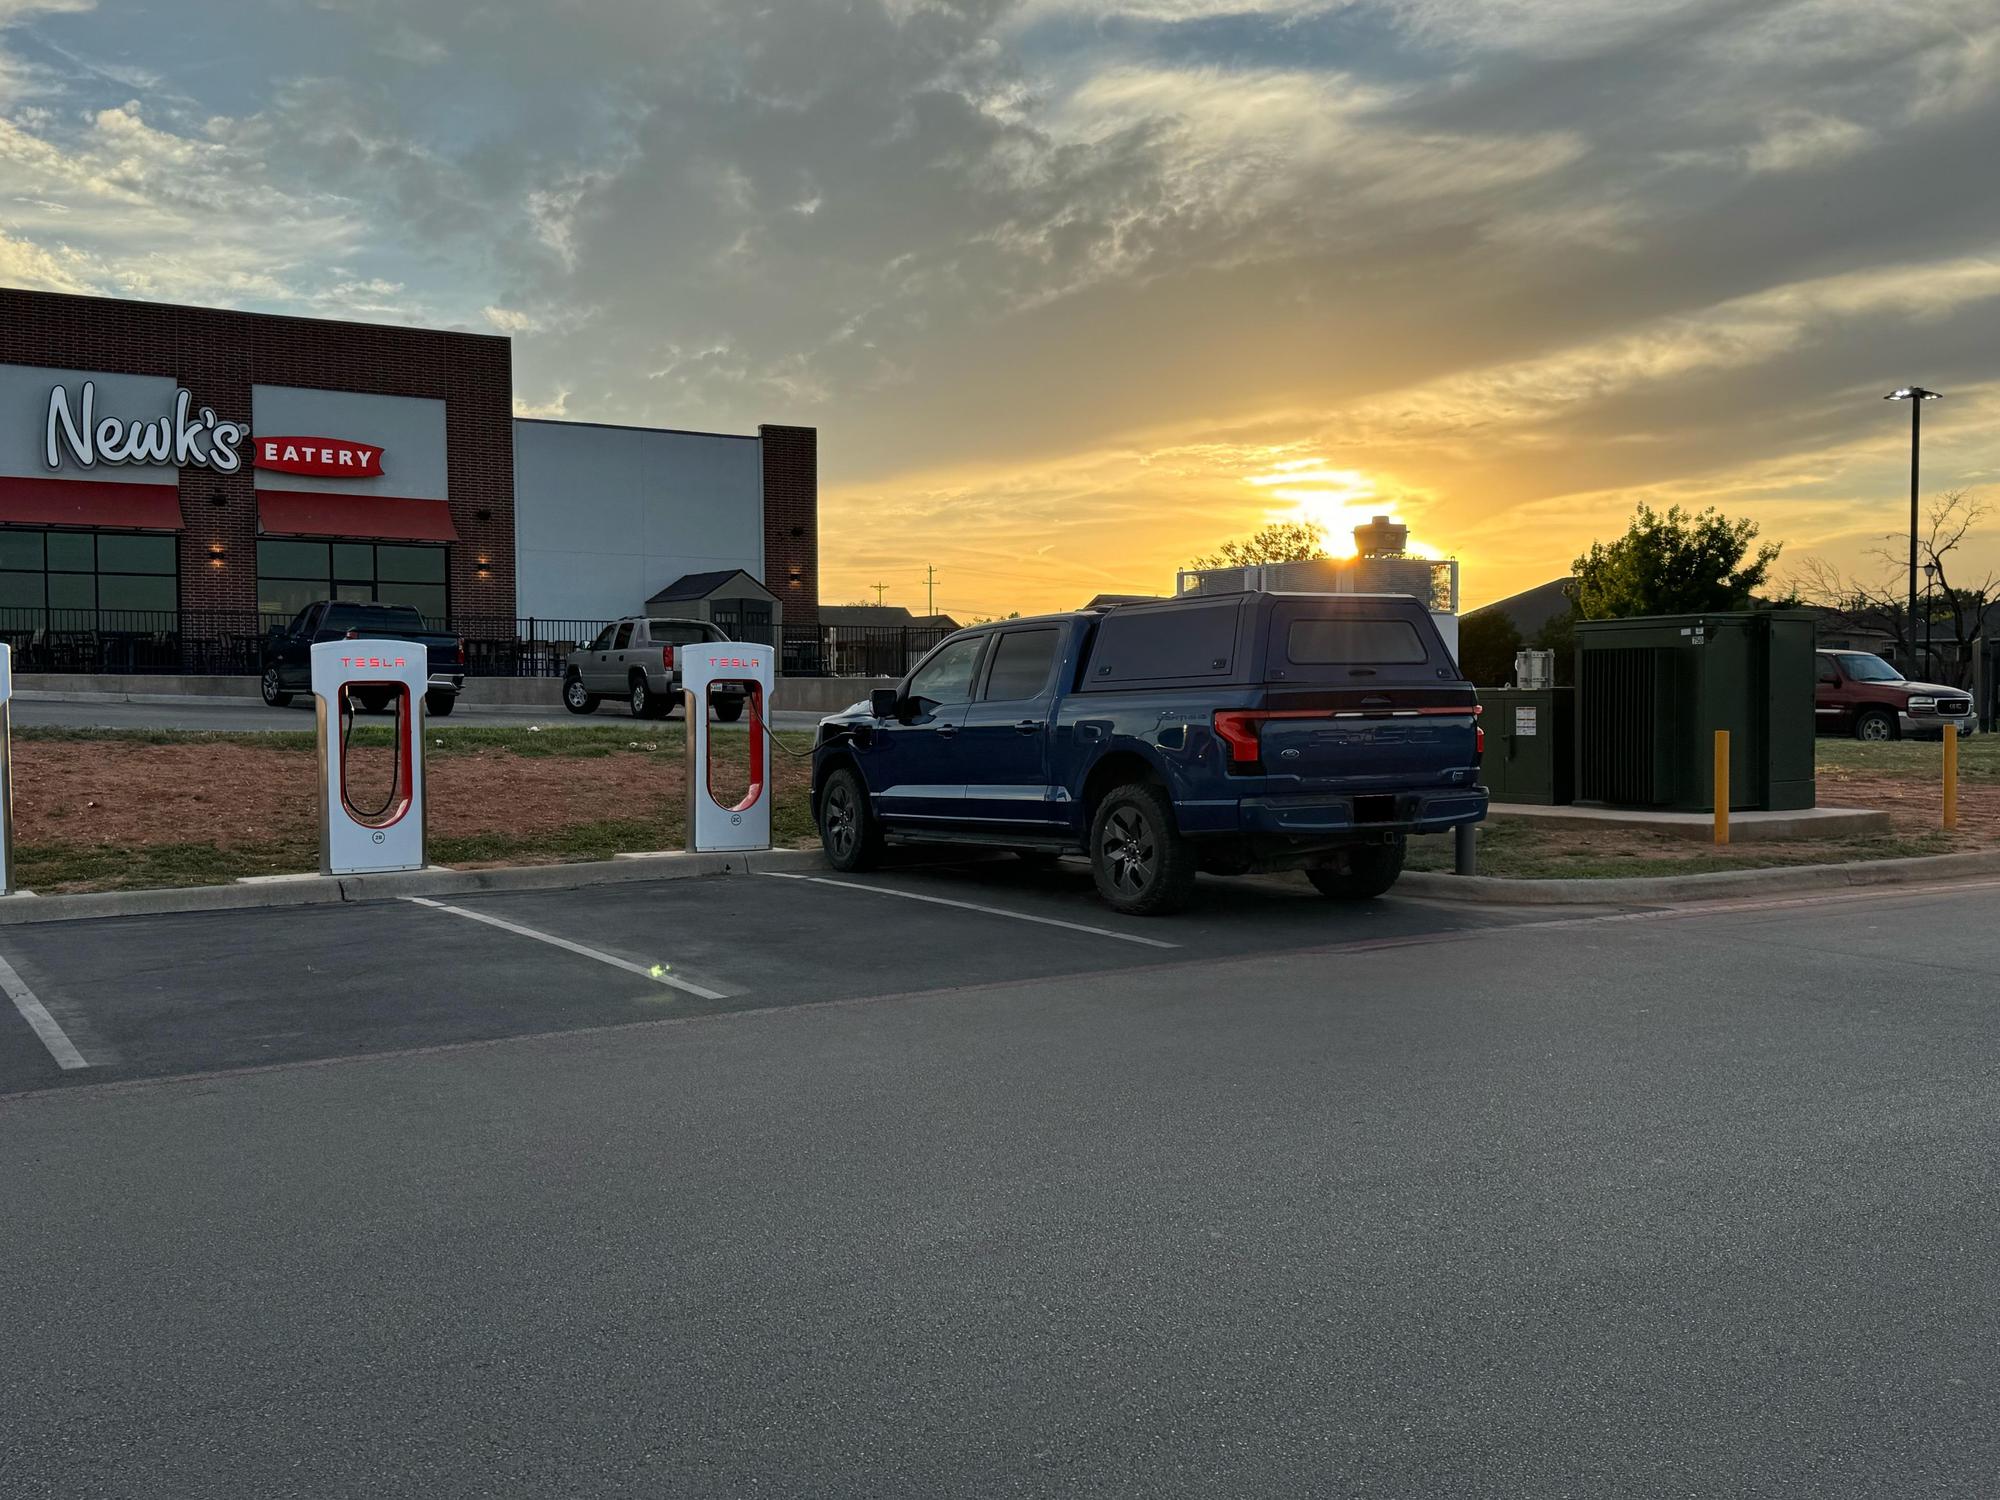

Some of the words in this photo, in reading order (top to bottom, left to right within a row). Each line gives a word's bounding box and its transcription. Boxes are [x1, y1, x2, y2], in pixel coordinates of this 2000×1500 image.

[45, 380, 242, 473] Newk's
[264, 442, 373, 468] EATERY
[340, 658, 406, 668] TESLA
[709, 658, 760, 667] TESLA
